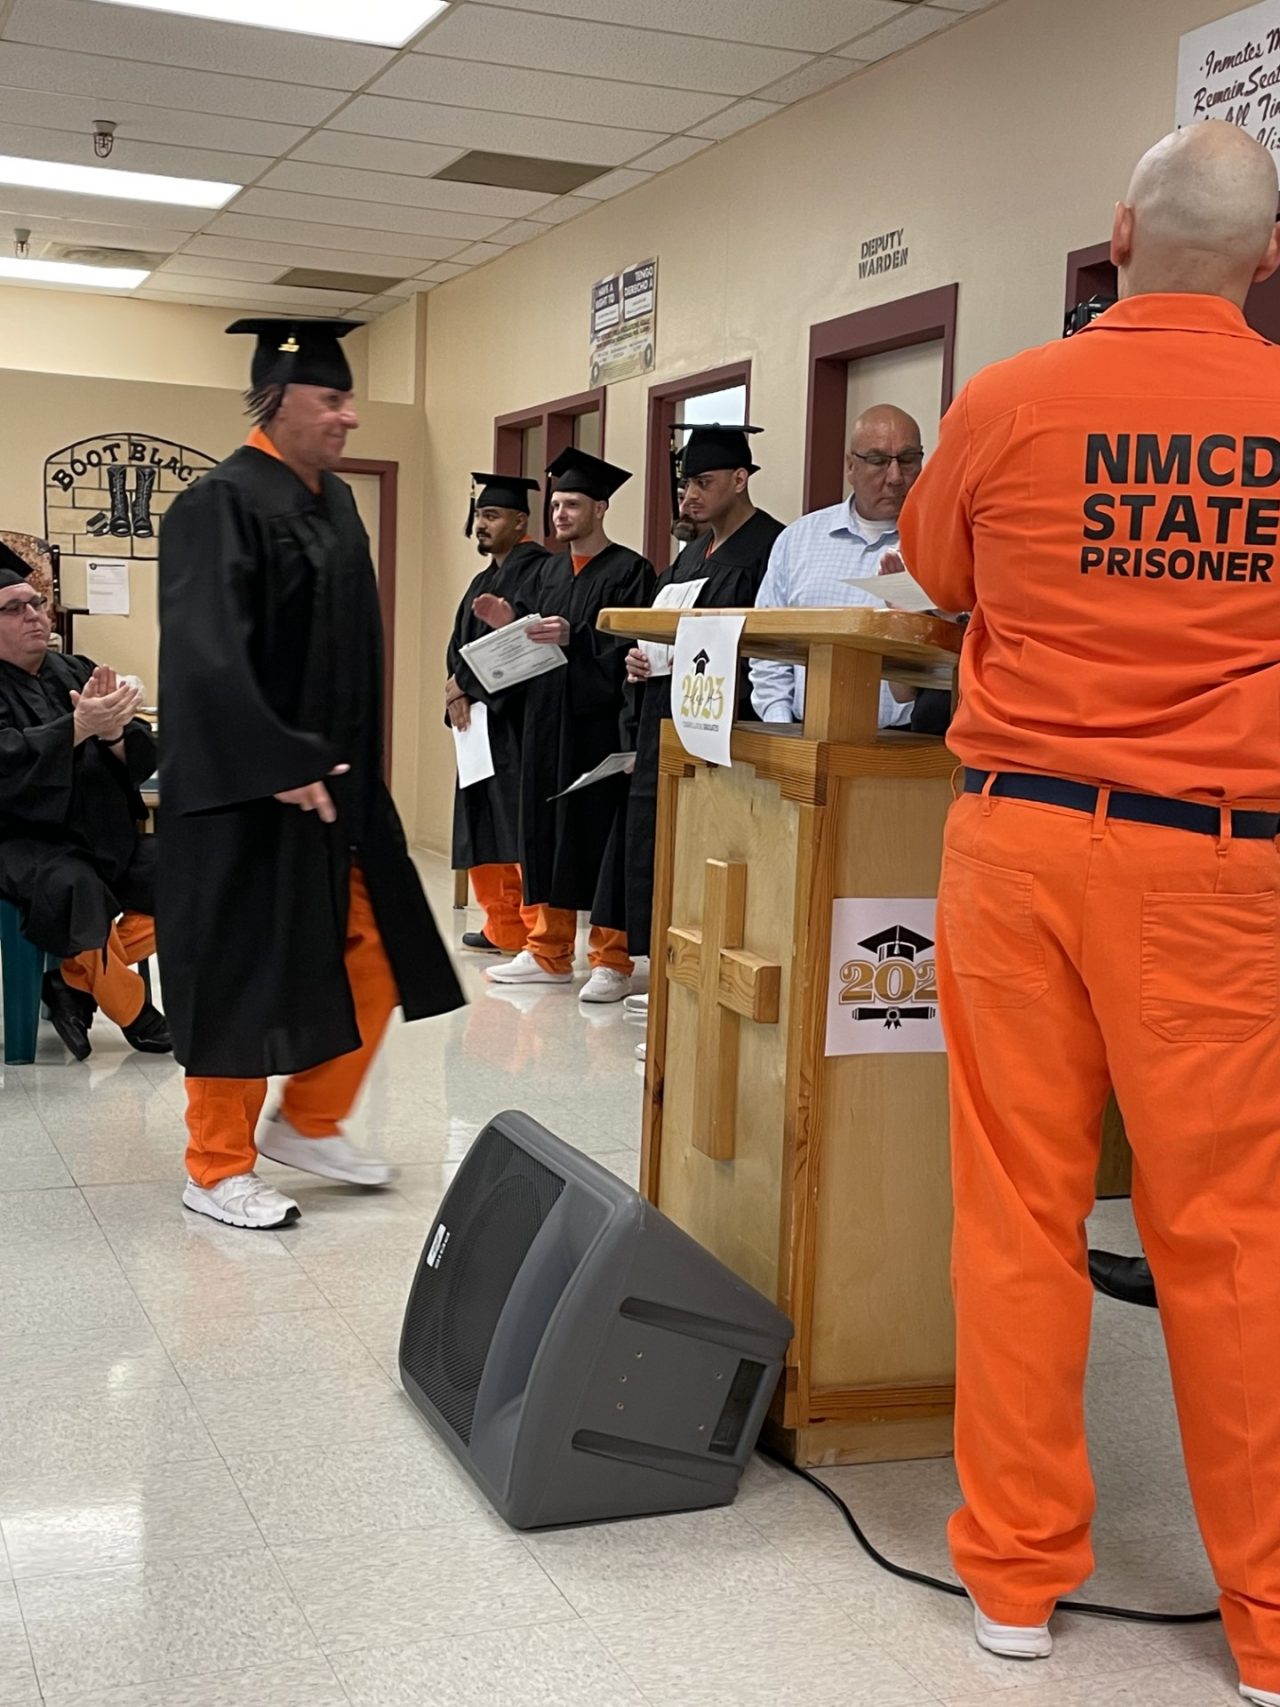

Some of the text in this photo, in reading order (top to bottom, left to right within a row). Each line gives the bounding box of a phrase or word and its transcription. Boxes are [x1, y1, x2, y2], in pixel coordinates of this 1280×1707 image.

[1205, 41, 1264, 80] Inmates
[1193, 80, 1246, 117] Remain
[858, 247, 909, 280] WARDEN
[861, 227, 904, 260] DEPUTY
[52, 442, 200, 492] BOOT BLAC
[1085, 433, 1280, 487] NMCD
[1083, 493, 1280, 546] STATE
[1080, 546, 1274, 583] PRISONER
[680, 674, 725, 720] 2023
[839, 959, 939, 1005] 202
